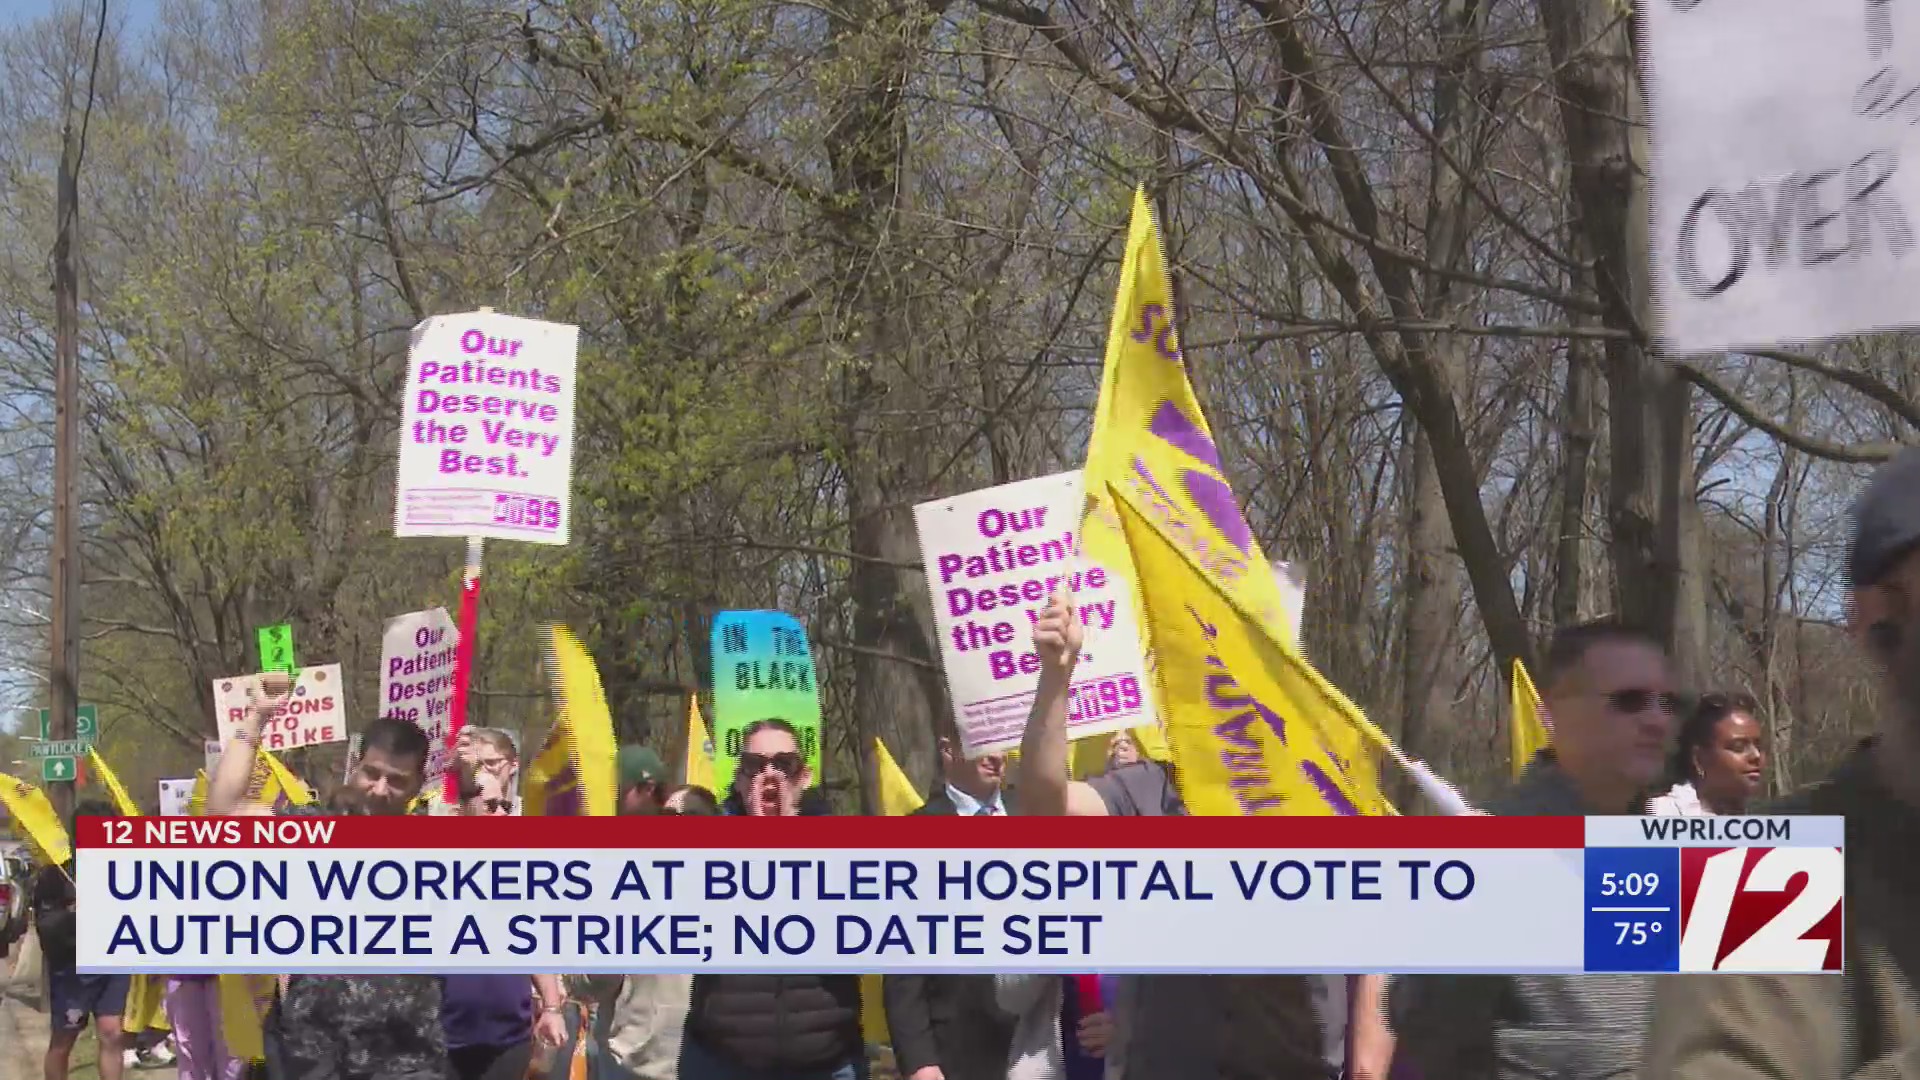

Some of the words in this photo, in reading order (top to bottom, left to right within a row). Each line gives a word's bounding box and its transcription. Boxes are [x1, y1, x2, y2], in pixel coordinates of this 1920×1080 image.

[1675, 150, 1917, 300] OVER
[460, 329, 523, 357] Our
[418, 360, 561, 393] Patients
[416, 389, 558, 422] Deserve
[412, 419, 469, 444] the
[482, 419, 559, 457] Very
[439, 449, 529, 477] Best.
[977, 506, 1049, 538] Our
[415, 626, 445, 648] Our
[722, 622, 749, 654] IN
[771, 626, 808, 656] THE
[951, 620, 1016, 651] the
[735, 661, 812, 692] BLACK
[229, 696, 334, 722] RSONS
[425, 696, 456, 718] Ver
[261, 725, 334, 749] RIKE
[269, 717, 299, 732] TO
